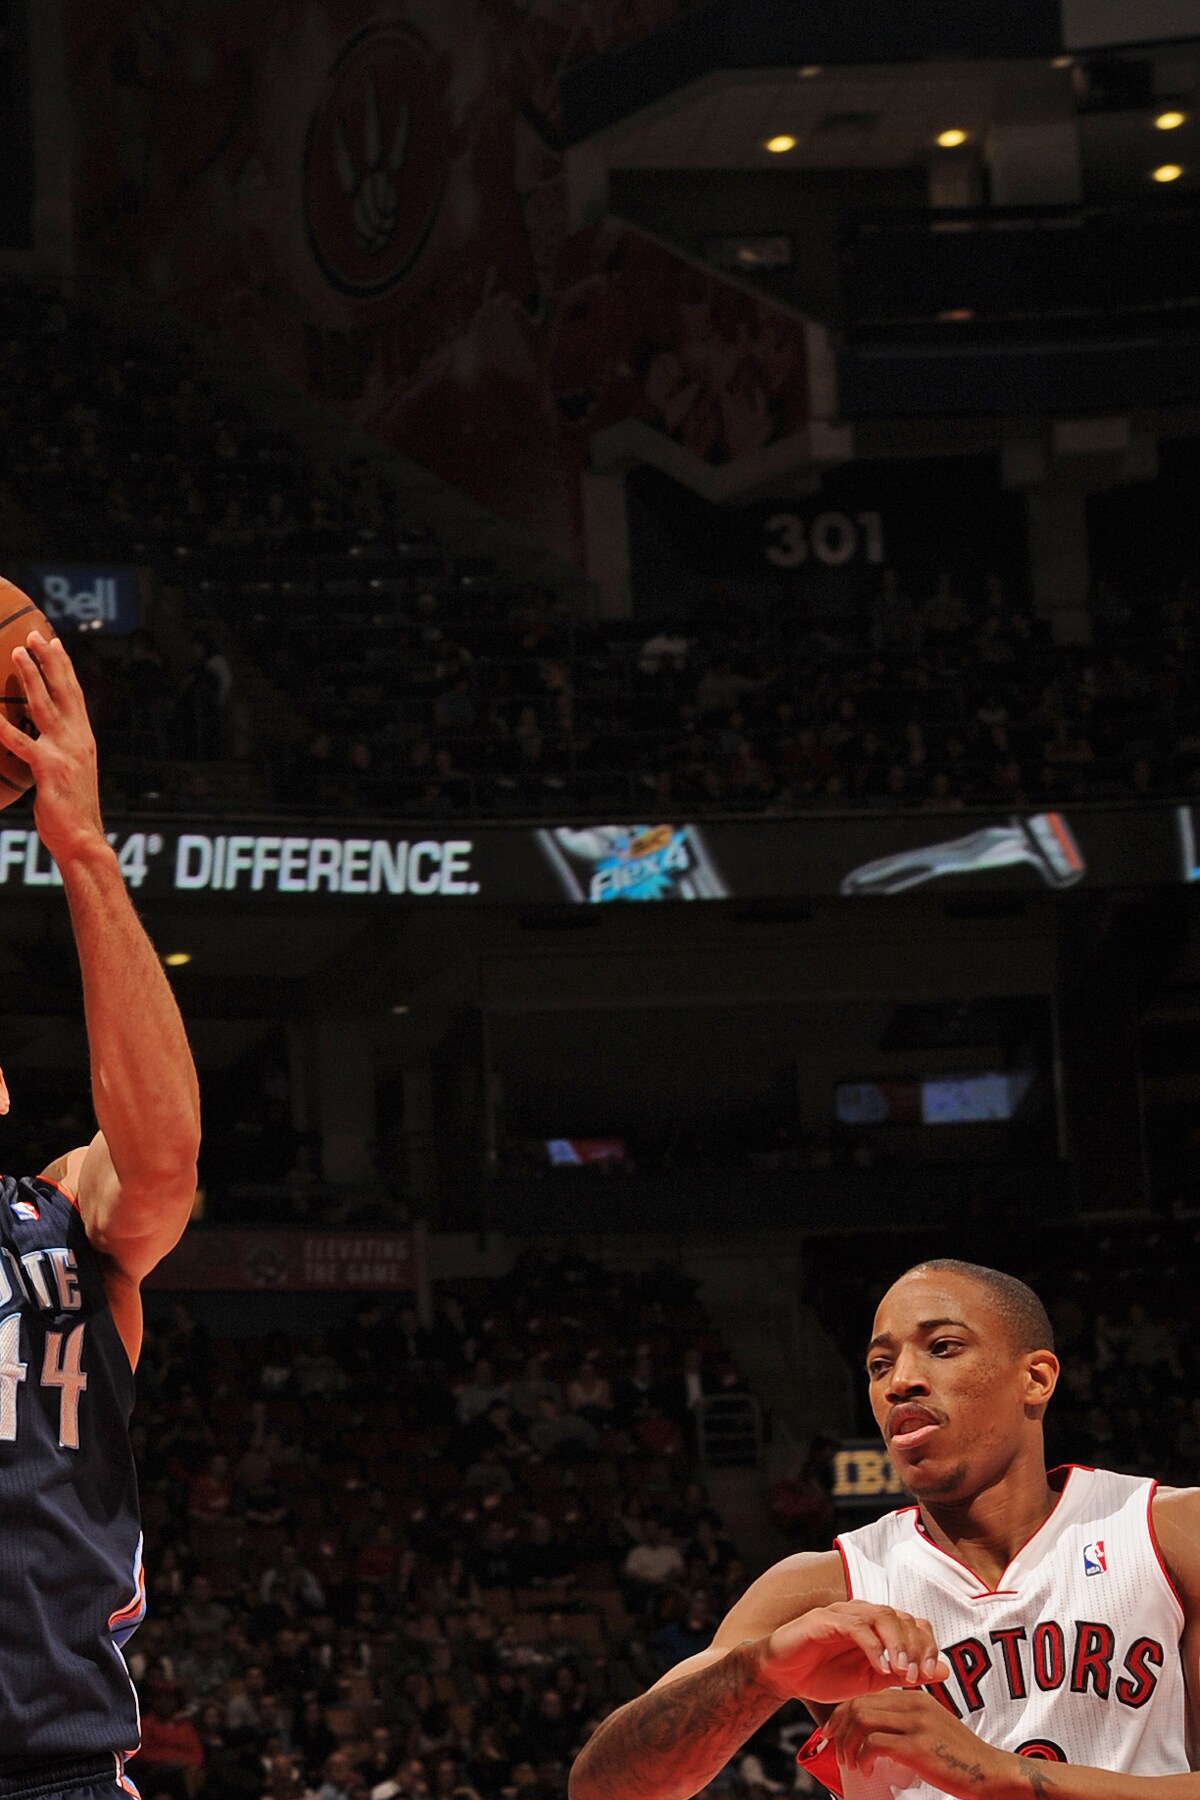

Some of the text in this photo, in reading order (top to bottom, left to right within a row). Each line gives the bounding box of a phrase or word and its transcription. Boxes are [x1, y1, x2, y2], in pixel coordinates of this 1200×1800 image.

[763, 510, 886, 569] 301
[43, 575, 117, 622] Bell
[175, 835, 479, 895] DIFFERENCE.
